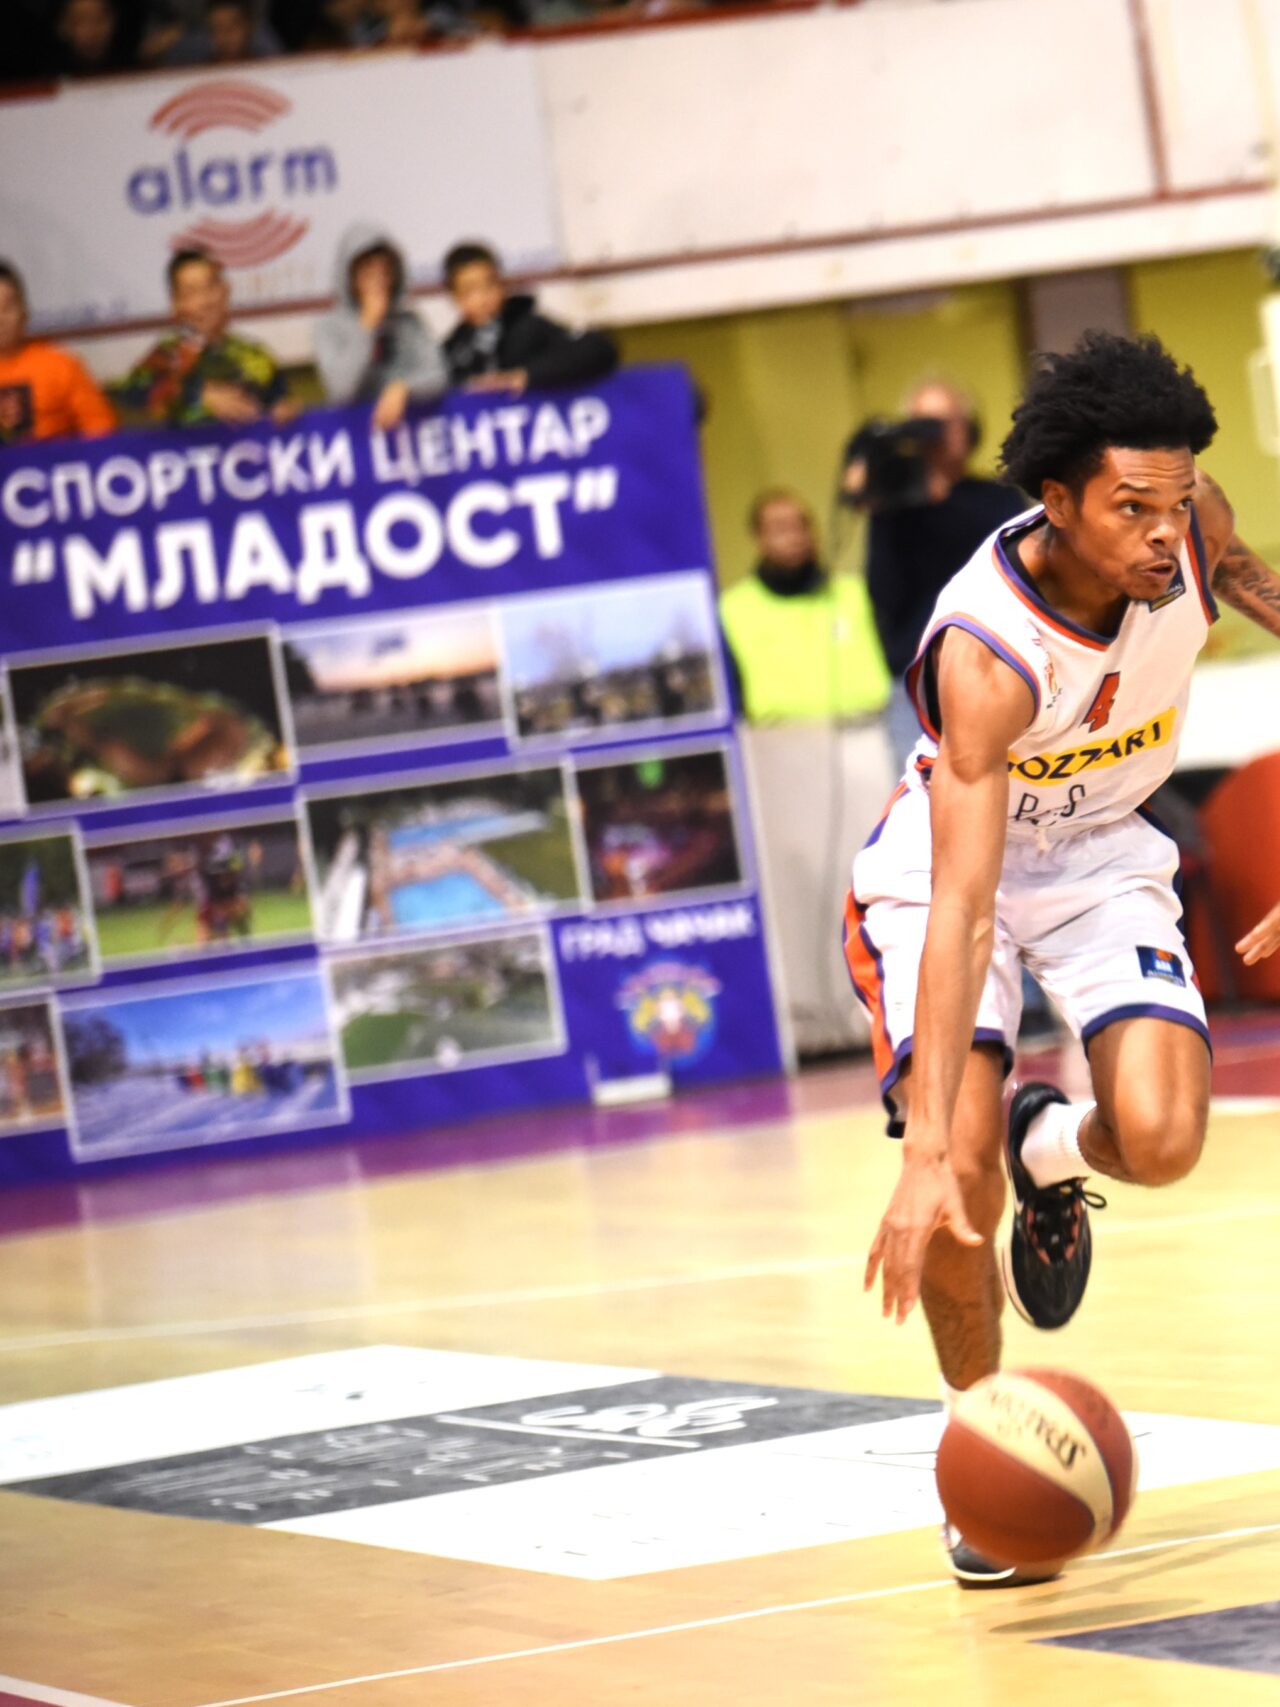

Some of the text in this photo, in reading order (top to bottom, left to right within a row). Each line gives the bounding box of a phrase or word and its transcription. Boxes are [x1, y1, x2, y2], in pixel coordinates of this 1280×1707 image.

[126, 145, 338, 214] alarm
[2, 398, 610, 527] СПОРТСКИ ЦЕНТАР
[1080, 671, 1121, 733] 4
